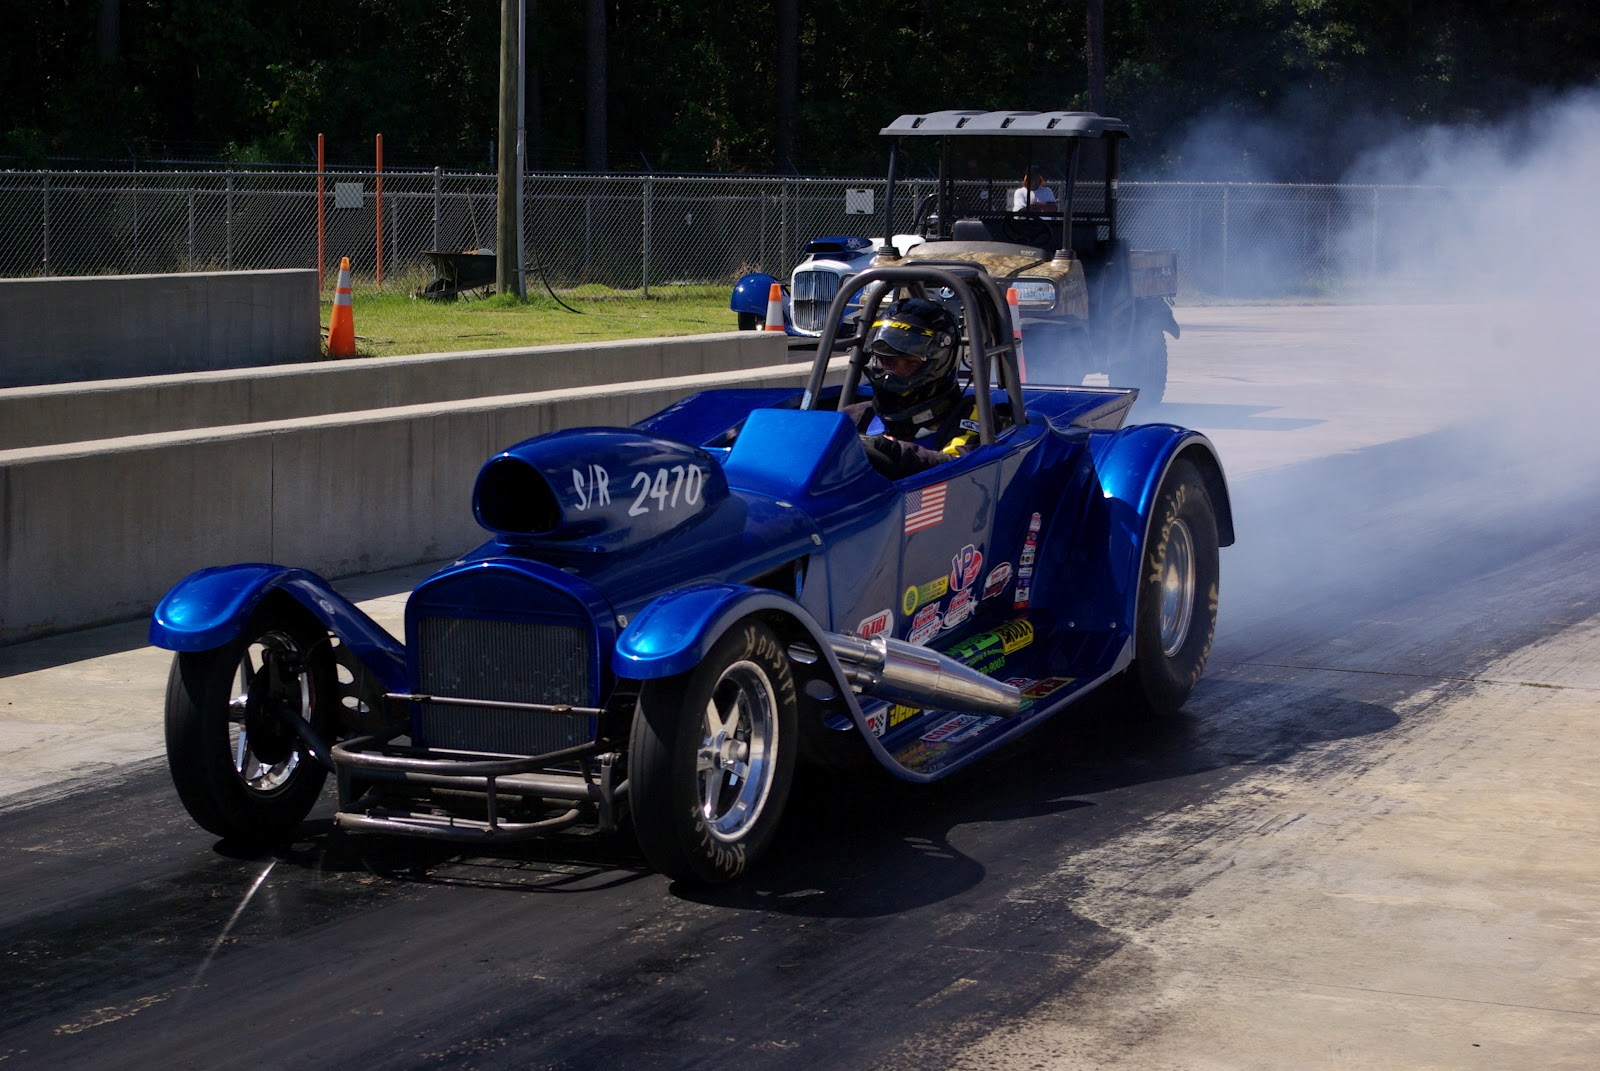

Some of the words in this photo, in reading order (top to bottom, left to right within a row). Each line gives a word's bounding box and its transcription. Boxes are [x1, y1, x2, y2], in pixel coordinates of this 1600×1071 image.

[572, 464, 611, 511] S/R
[628, 463, 703, 517] 2470
[951, 544, 975, 590] VP
